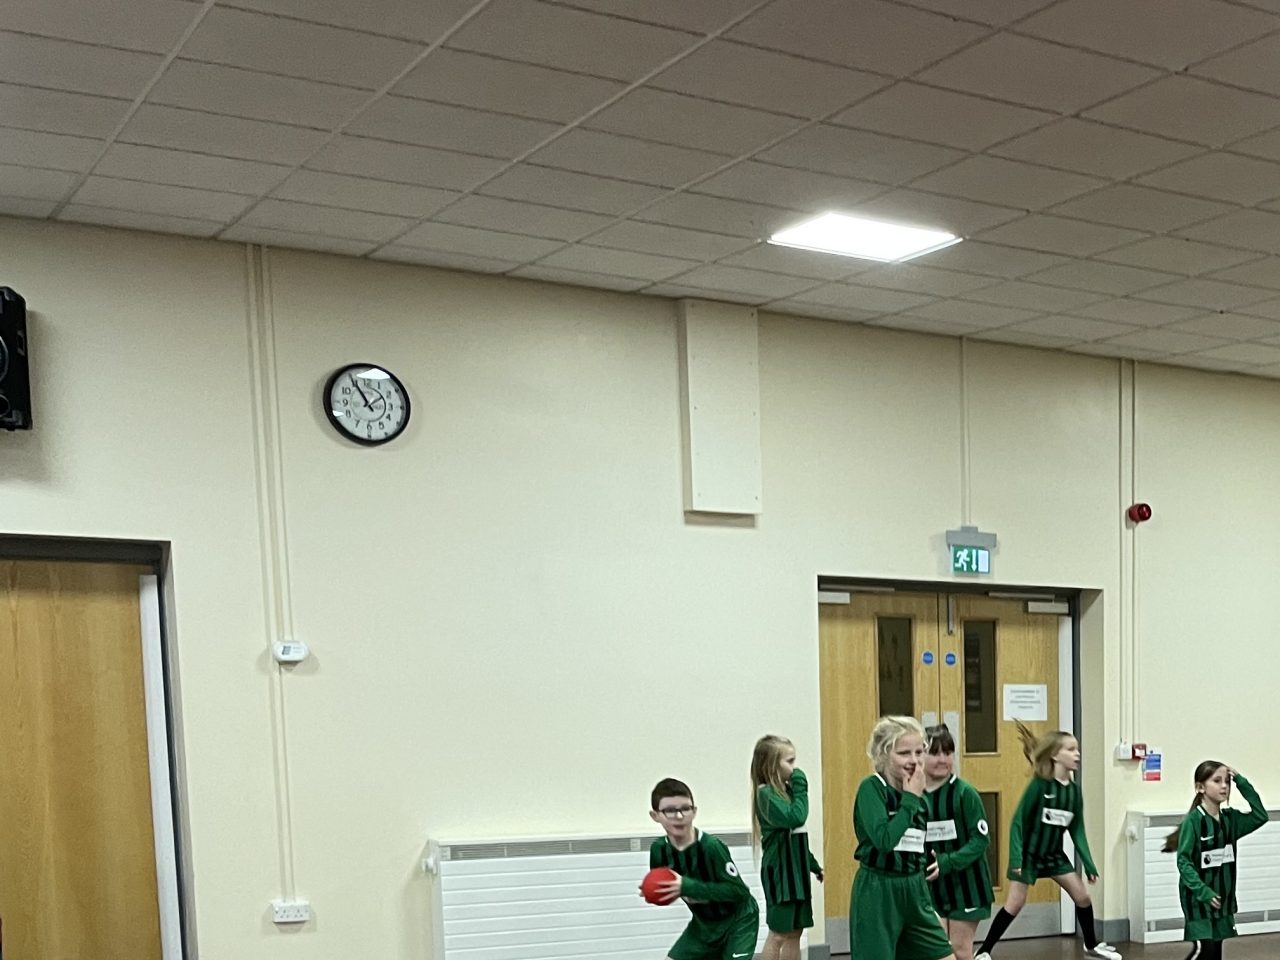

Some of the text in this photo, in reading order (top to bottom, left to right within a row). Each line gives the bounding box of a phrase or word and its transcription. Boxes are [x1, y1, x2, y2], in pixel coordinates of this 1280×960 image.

[341, 386, 352, 395] 10
[342, 399, 348, 407] 9
[354, 420, 360, 428] 7
